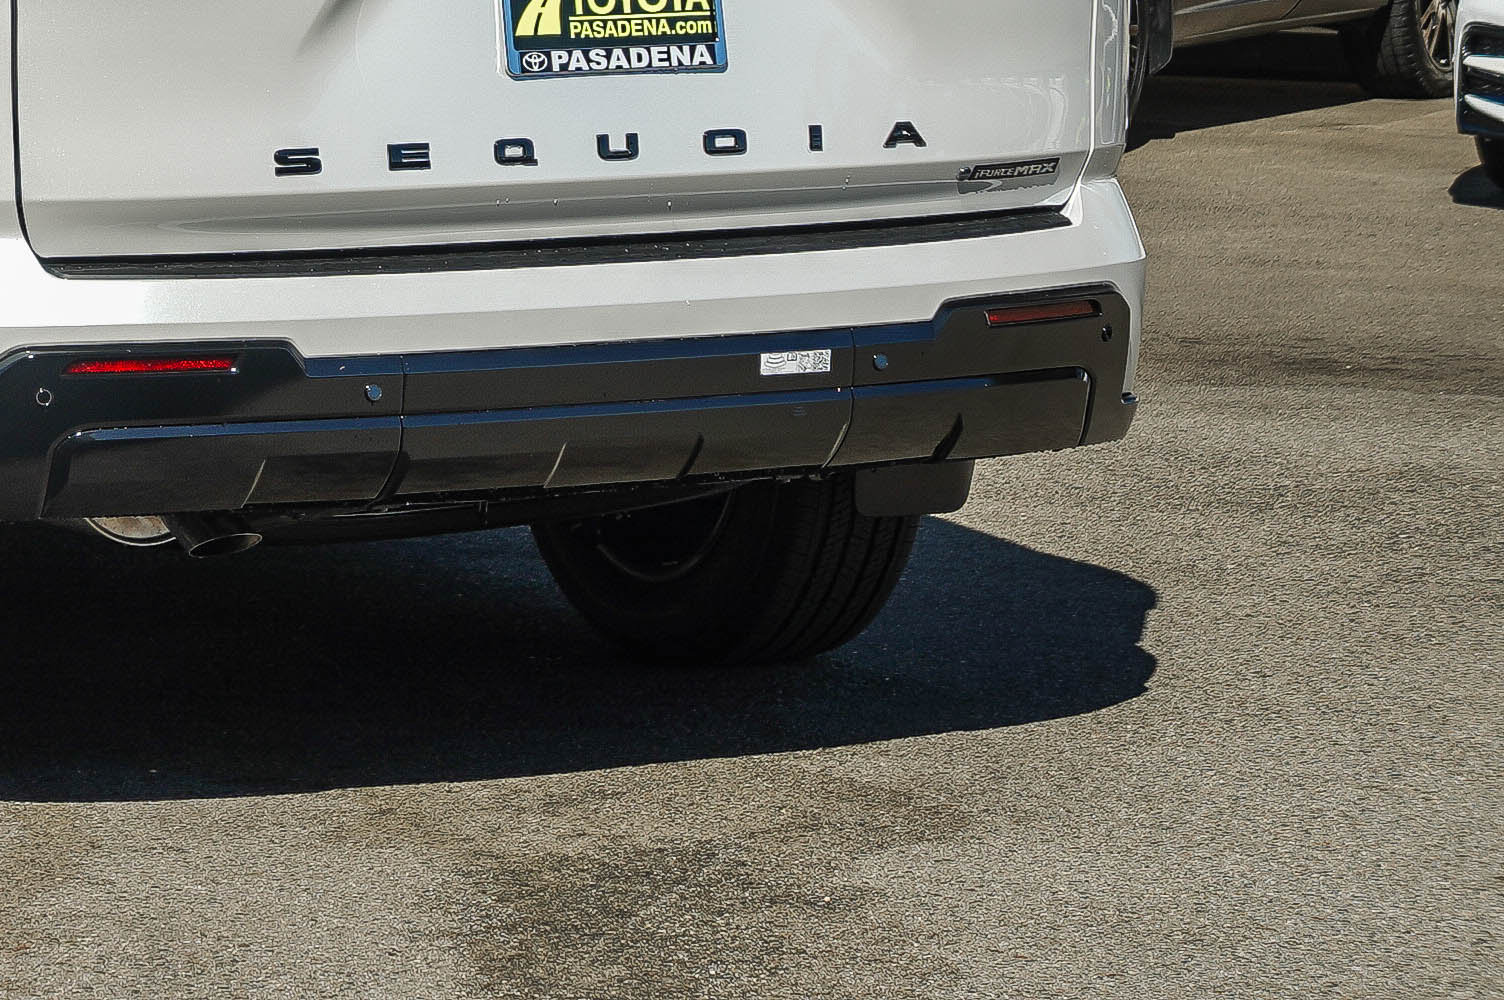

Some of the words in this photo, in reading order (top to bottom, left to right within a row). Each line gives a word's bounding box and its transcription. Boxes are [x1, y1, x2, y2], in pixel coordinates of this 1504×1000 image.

[569, 18, 713, 39] PASADENA.com
[551, 44, 714, 72] PASADENA
[273, 121, 928, 177] SEQUOIA
